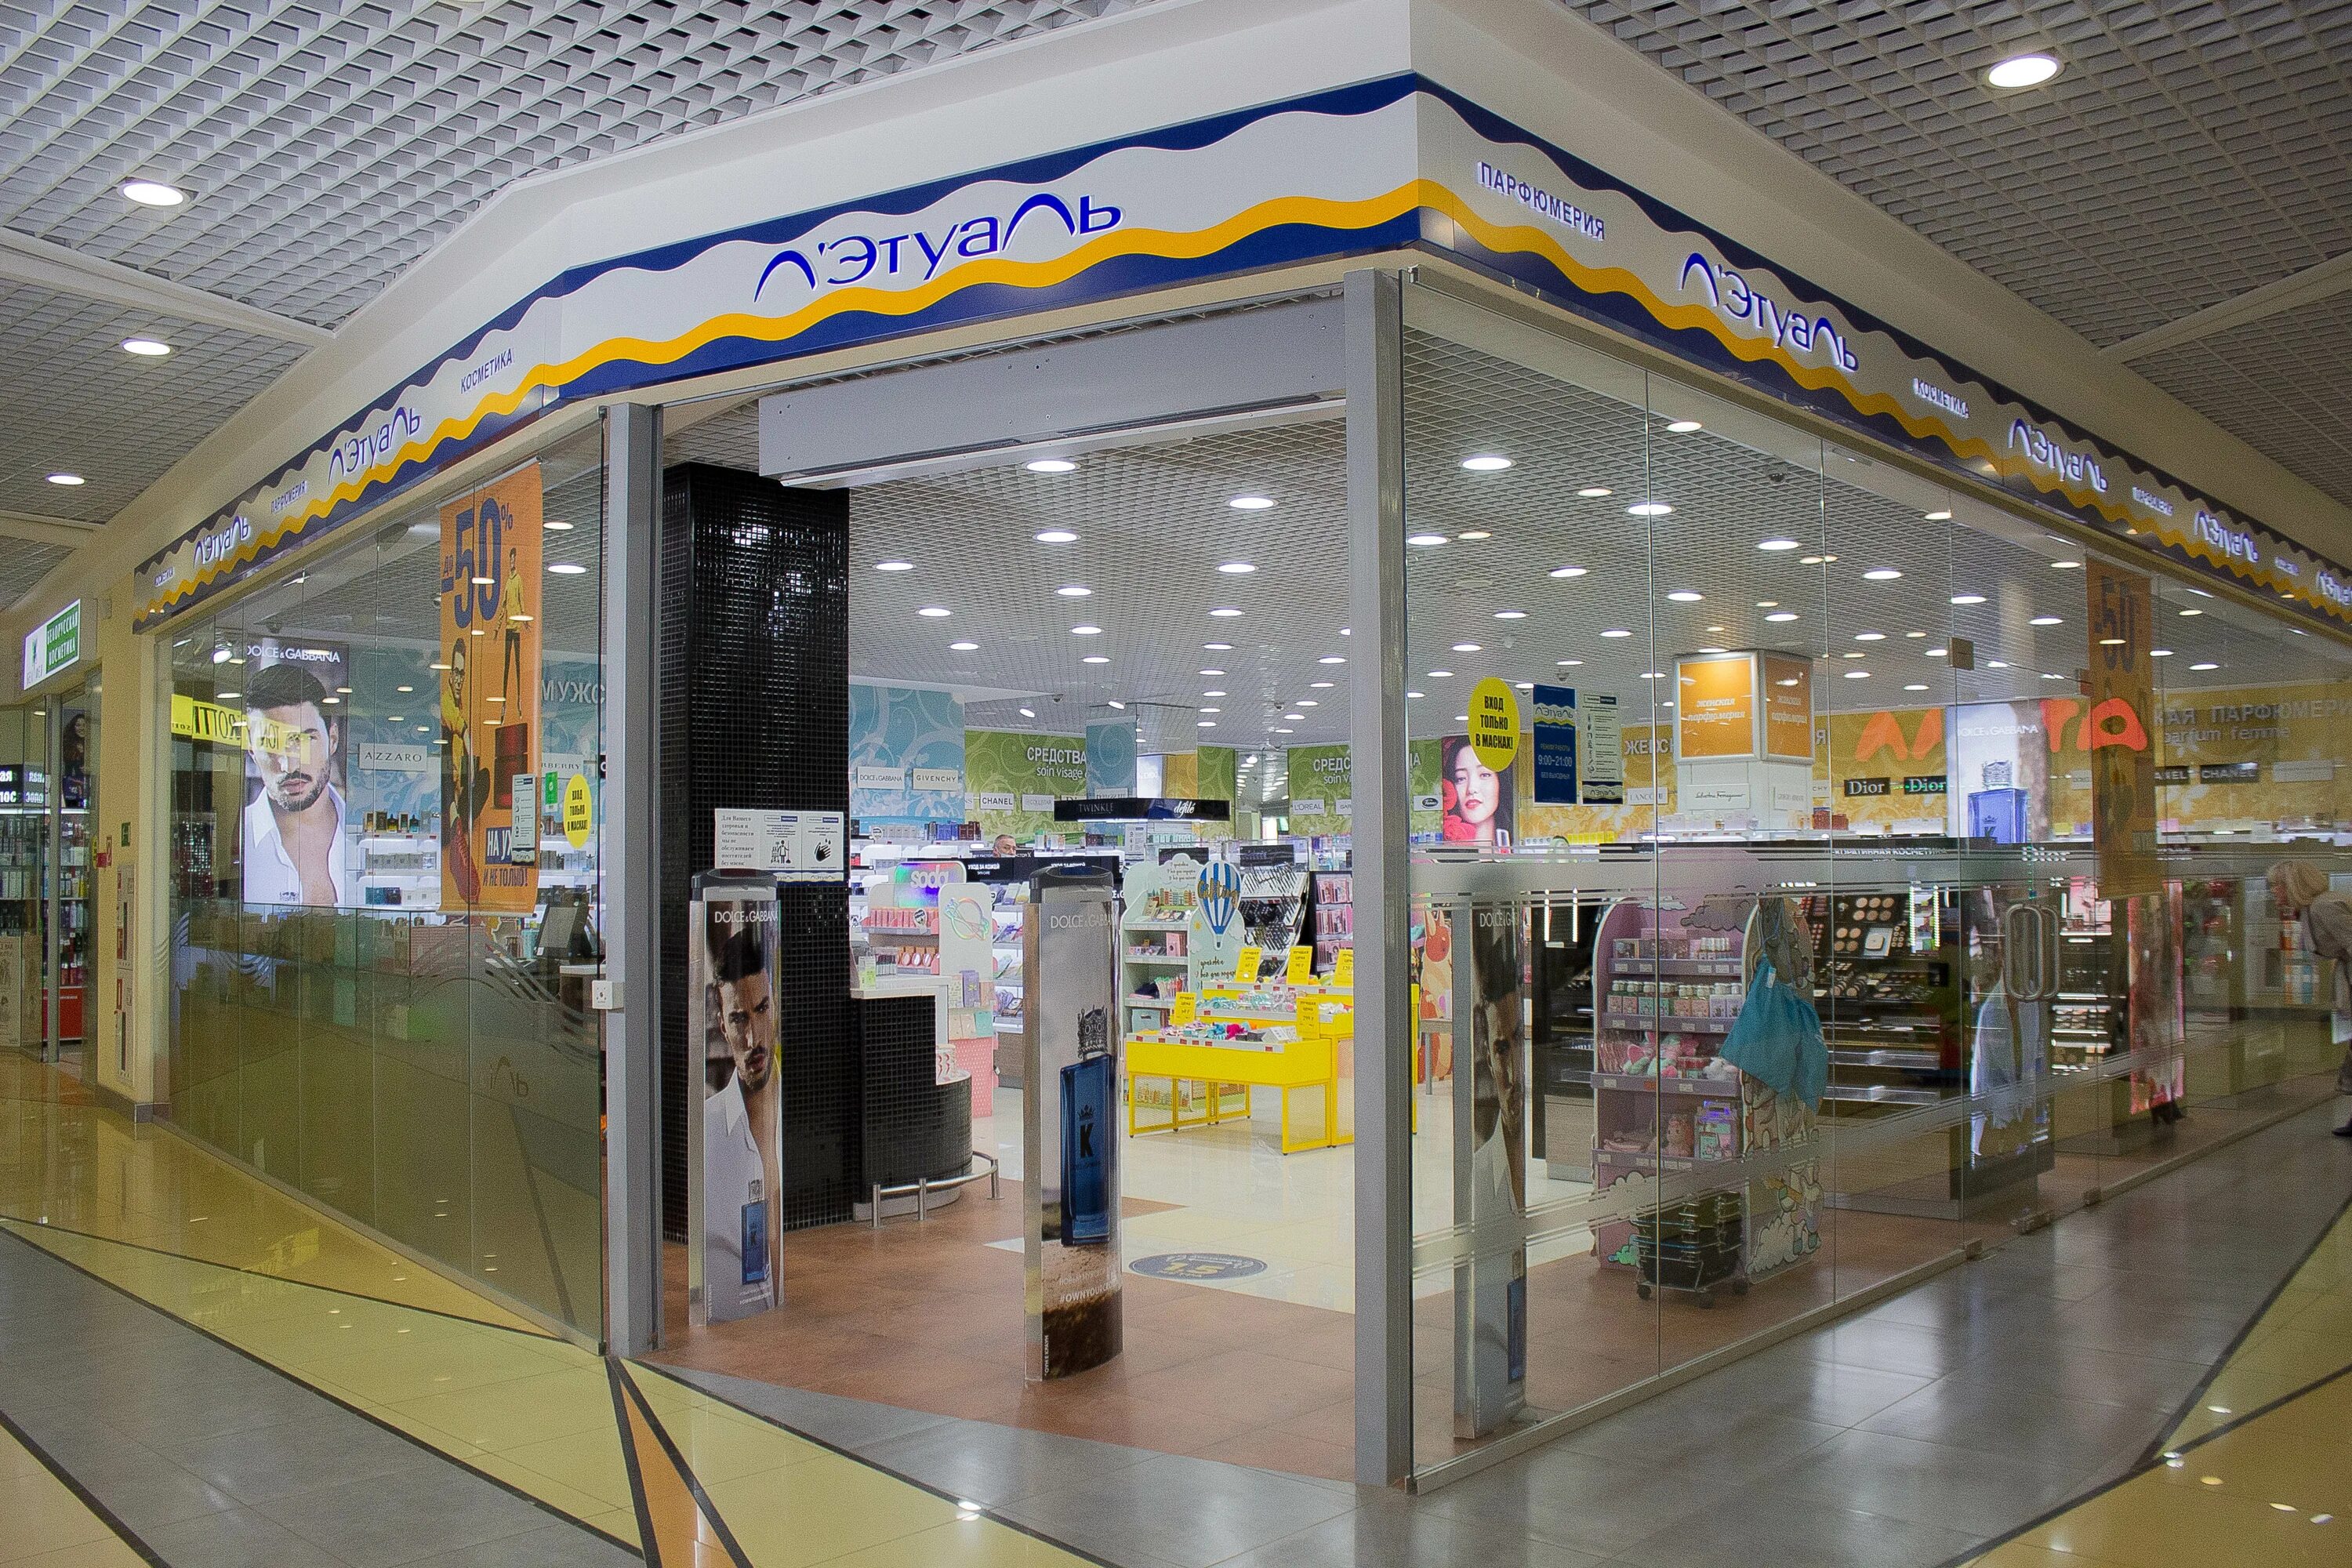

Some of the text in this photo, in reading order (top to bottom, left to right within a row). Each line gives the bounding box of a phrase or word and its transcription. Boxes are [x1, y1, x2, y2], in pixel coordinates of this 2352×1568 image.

[1477, 160, 1605, 241] ПАРФЮМЕРИЯ
[461, 348, 514, 394] КОСМЕТИКА
[1913, 377, 1969, 419] КОСМЕТИКА
[271, 480, 308, 513] ПАРФЮМЕРИЯ
[1484, 695, 1504, 713] ВХОД
[1480, 714, 1508, 731] ТОЛЬКО
[1475, 733, 1513, 750] В МАСКАХ!
[365, 752, 422, 762] AZZARO
[1027, 746, 1087, 765] СРЕДСТВА
[1537, 754, 1573, 768] 9:00-21:00
[1036, 765, 1083, 780] soin visage
[1313, 757, 1352, 773] СРЕДС
[1323, 773, 1341, 784] soin
[1908, 778, 1946, 793] Dior
[572, 789, 583, 800] ВХОД
[1849, 781, 1886, 795] Dior
[982, 797, 1013, 806] CHANEL
[1078, 803, 1113, 812] TWINKLE
[569, 804, 585, 817] ТОЛЬКО
[567, 819, 588, 832] В МАСКАХ!
[487, 829, 499, 857] НА
[483, 869, 488, 886] И
[490, 869, 498, 887] НЕ
[910, 864, 949, 889] soda
[1197, 877, 1240, 907] Gifting
[1080, 1123, 1094, 1159] K
